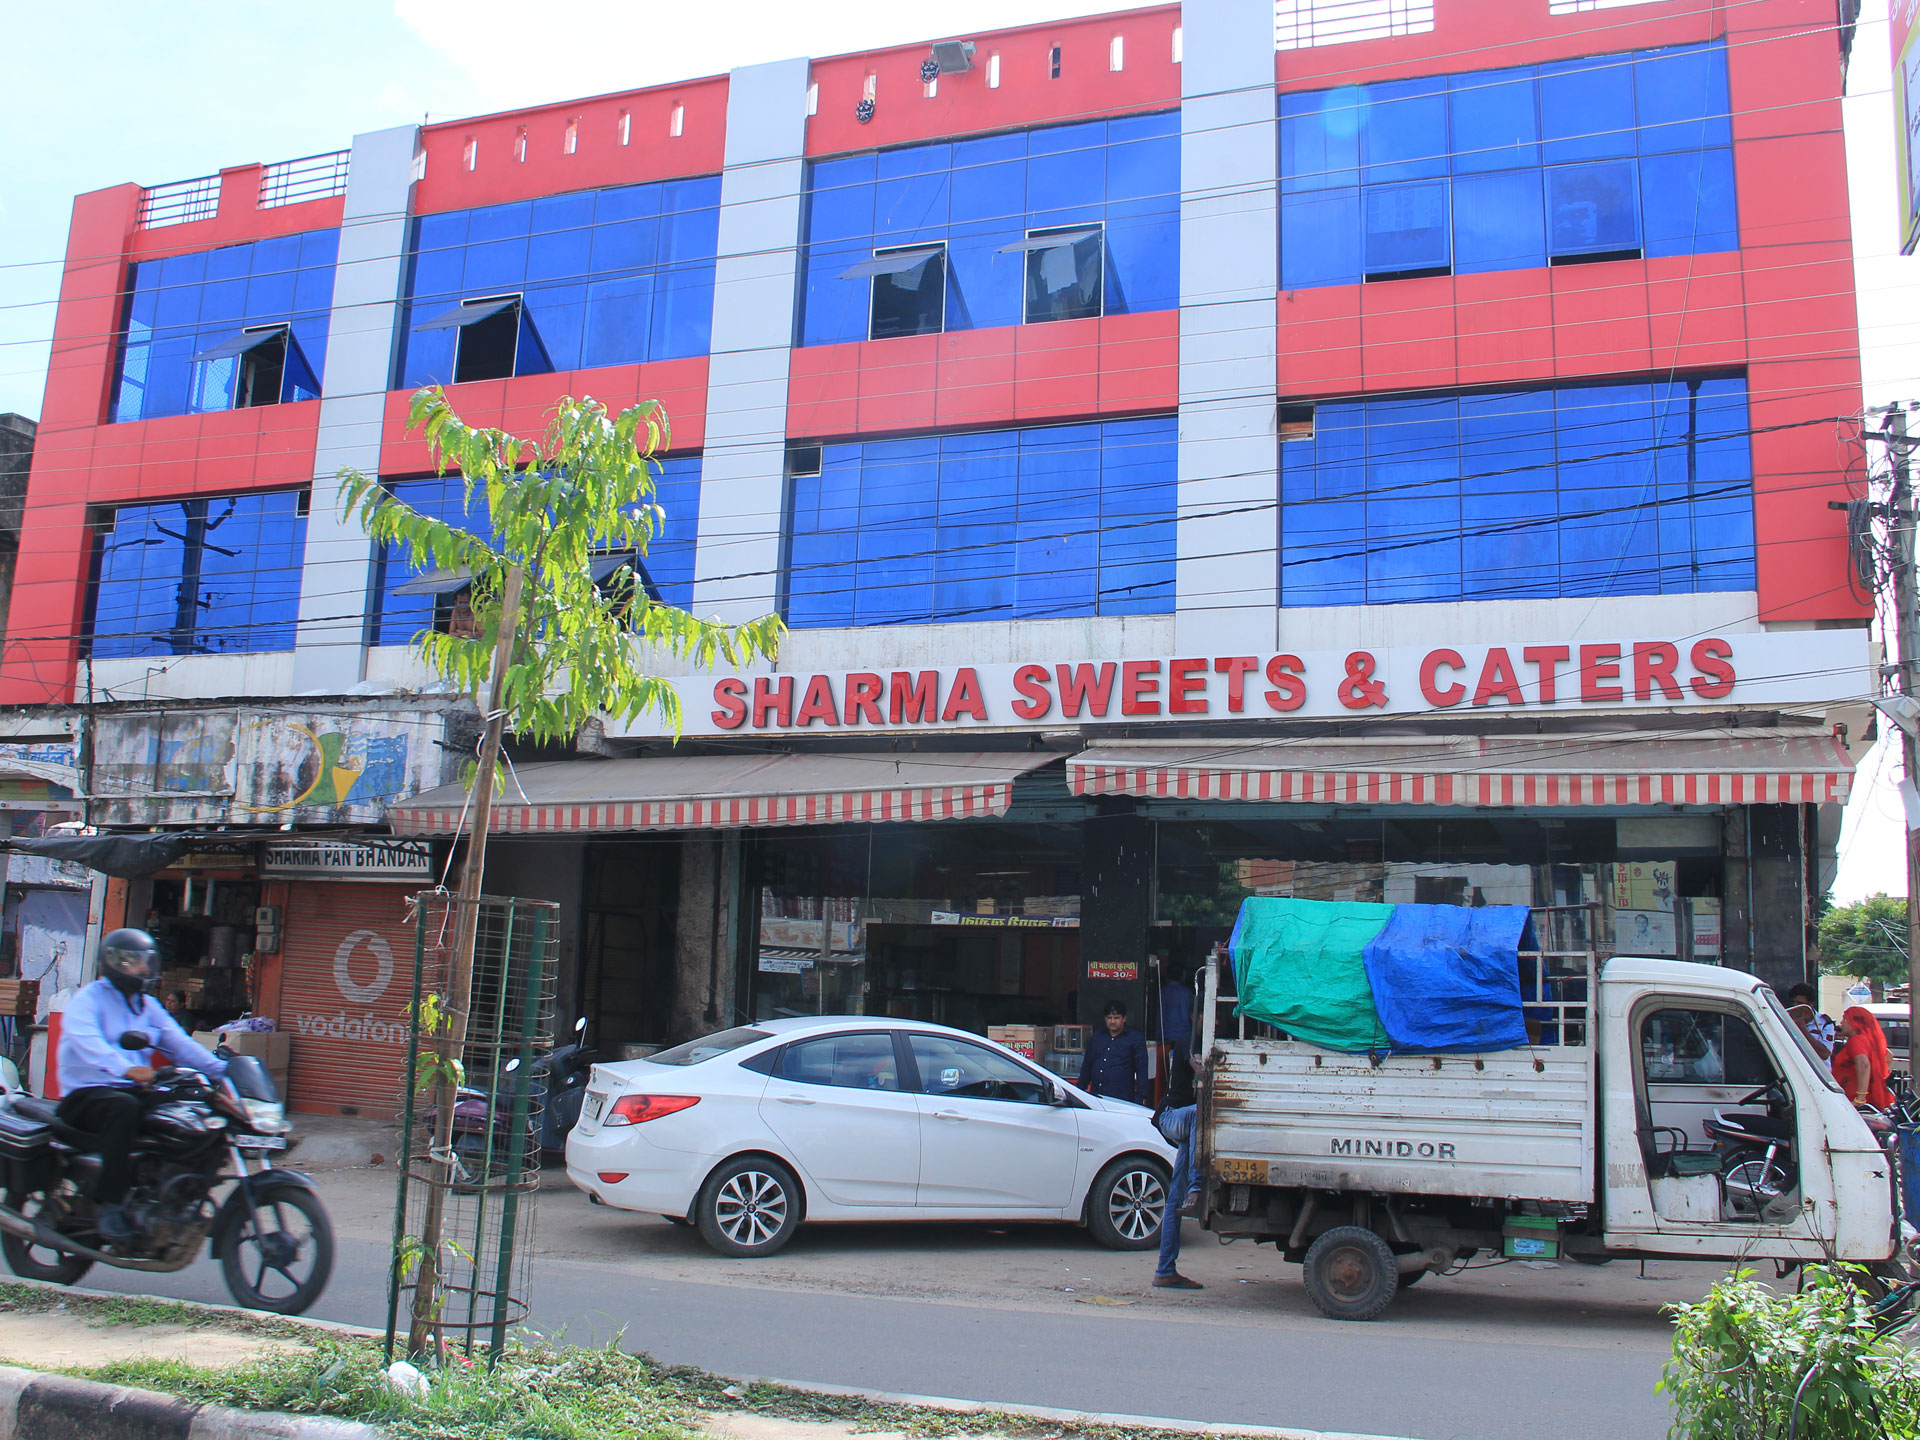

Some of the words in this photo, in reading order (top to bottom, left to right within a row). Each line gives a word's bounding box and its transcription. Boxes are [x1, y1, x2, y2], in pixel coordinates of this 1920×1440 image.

[711, 667, 989, 730] SHARMA
[1011, 654, 1307, 719] SWEETS
[1337, 651, 1390, 709] &
[1419, 637, 1737, 706] CATERS
[266, 841, 321, 866] SHARMA
[324, 842, 351, 867] PAN
[356, 843, 428, 868] BHANDAR
[296, 1010, 421, 1044] vodafon
[1331, 1138, 1458, 1160] MINIDOR
